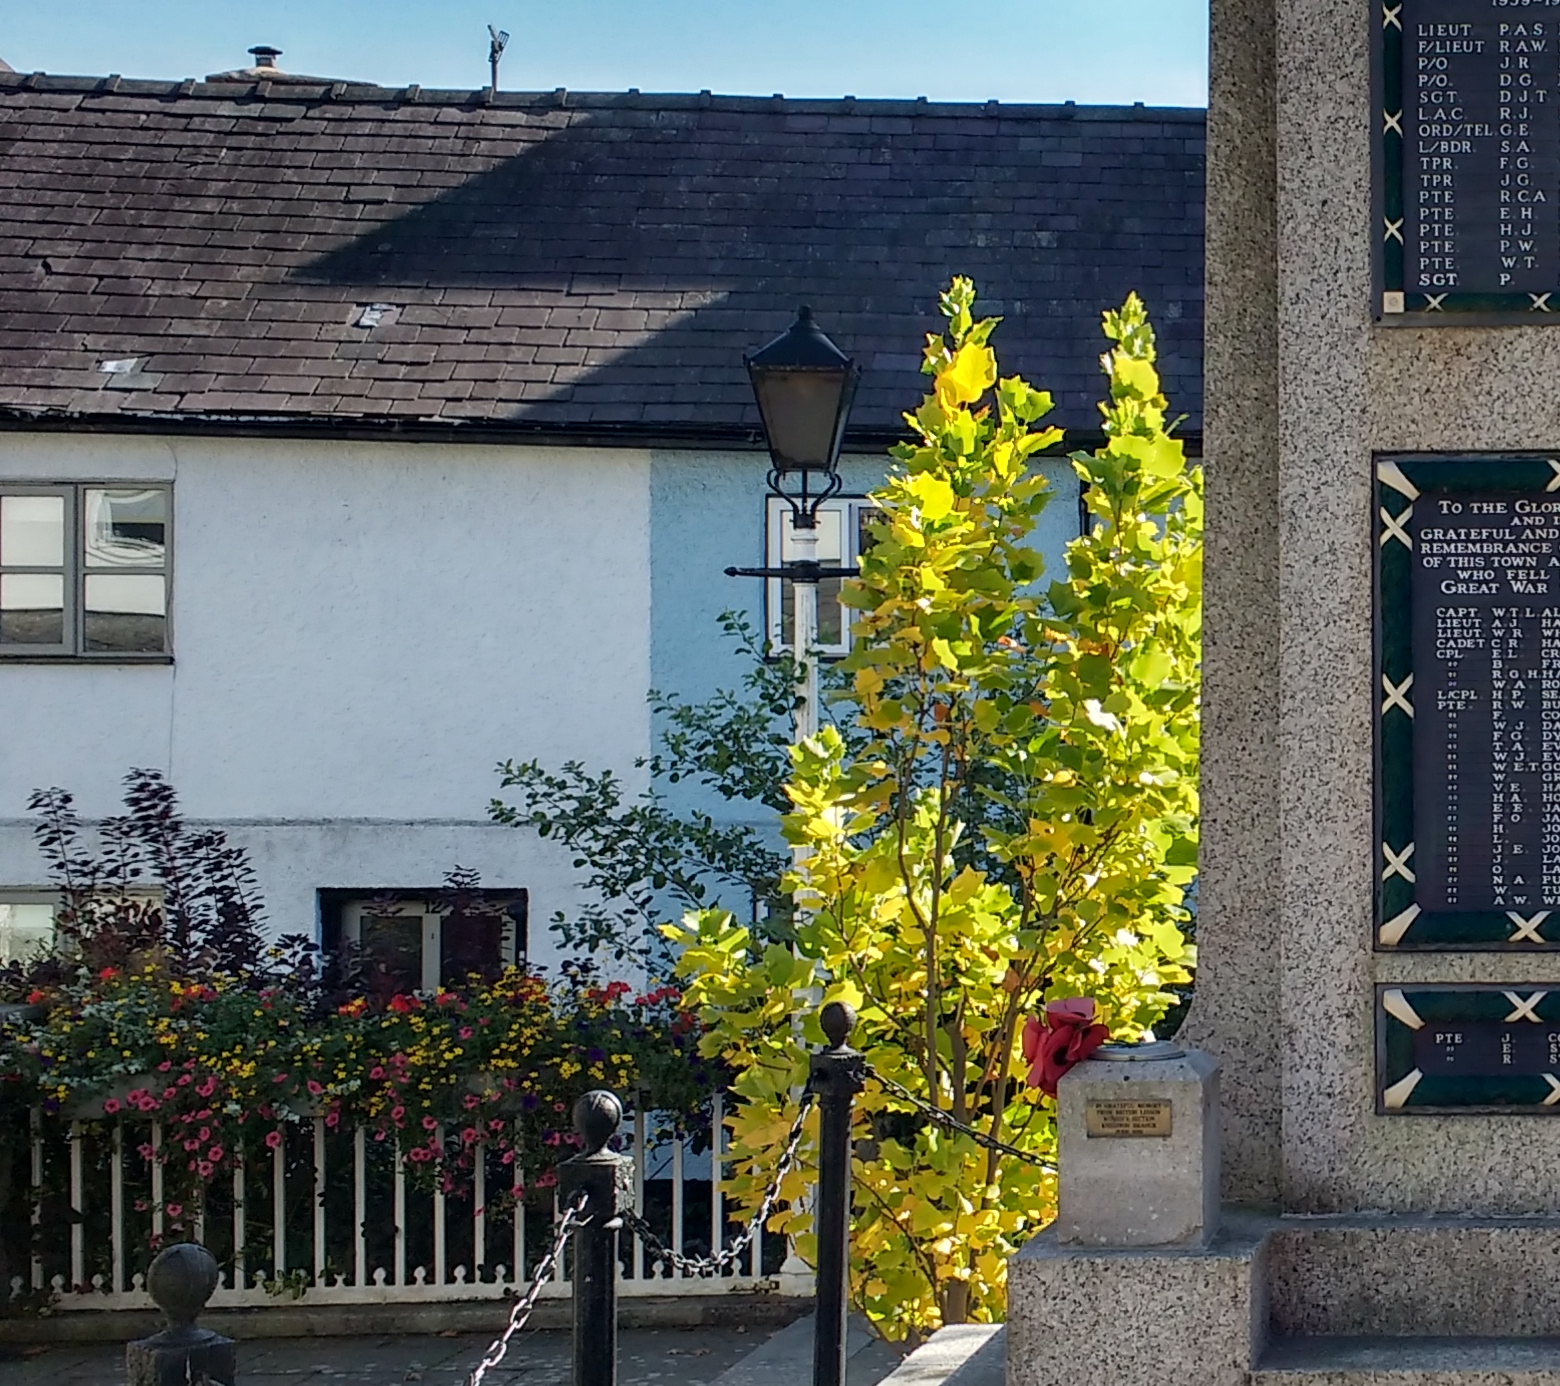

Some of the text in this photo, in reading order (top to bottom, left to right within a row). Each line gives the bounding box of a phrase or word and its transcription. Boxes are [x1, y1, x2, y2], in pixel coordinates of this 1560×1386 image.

[1418, 24, 1472, 37] LIEUT
[1418, 40, 1485, 54] F/LIEUT
[1418, 57, 1448, 71] P/O
[1420, 174, 1453, 187] TPR
[1419, 190, 1454, 204] PTE
[1419, 207, 1454, 221] PTE
[1438, 500, 1463, 515] TO
[1469, 502, 1508, 514] THE
[1509, 516, 1545, 526] AND
[1420, 528, 1517, 540] GRATEFUL
[1520, 528, 1560, 540] AND
[1420, 542, 1553, 554] REMEMBRANCE
[1422, 556, 1443, 568] OF
[1446, 556, 1485, 568] THIS
[1490, 556, 1537, 568] TOWN
[1456, 569, 1495, 581] WHO
[1506, 569, 1551, 580] FELL
[1440, 579, 1500, 595] GREAT
[1509, 580, 1548, 594] WAR
[1436, 607, 1478, 618] CAPT
[1437, 618, 1482, 628] LIEUT
[1436, 638, 1486, 649] CADET
[1436, 649, 1464, 659] CPL
[1435, 1033, 1463, 1044] PTE
